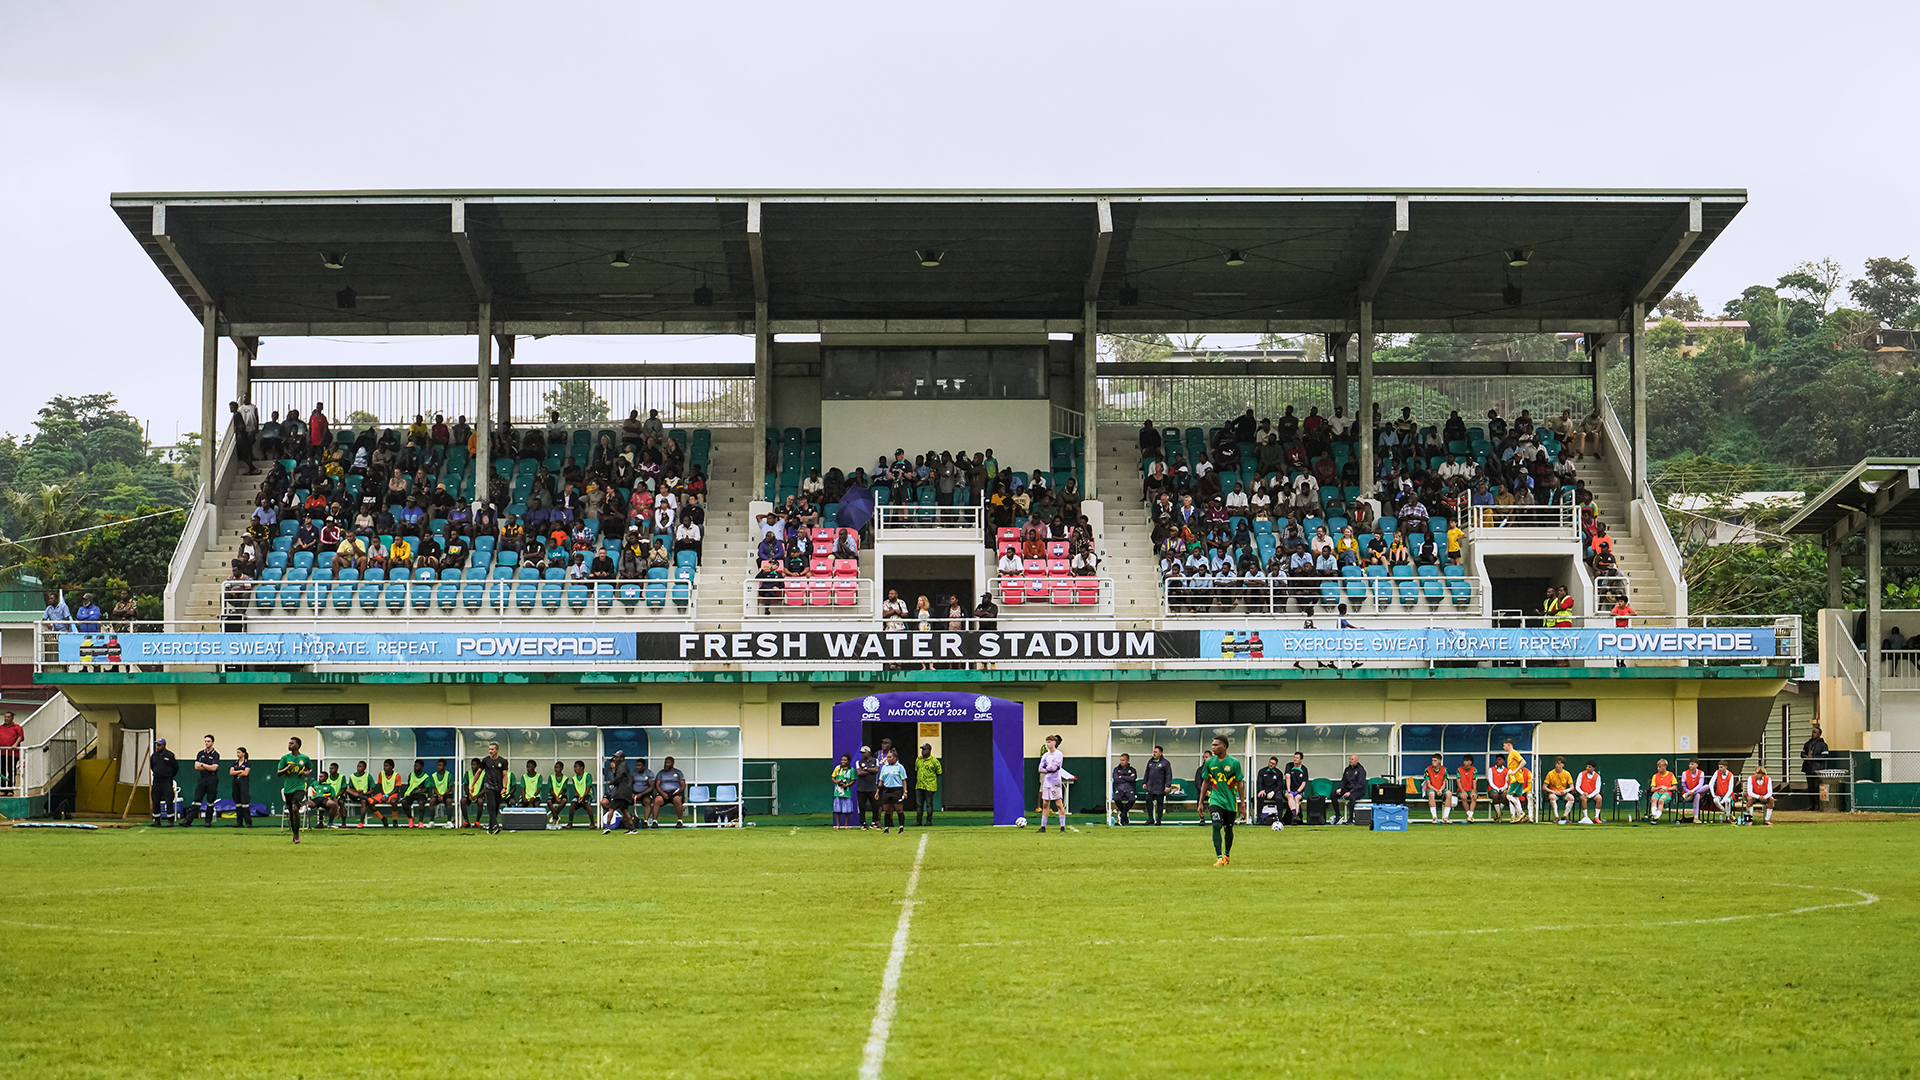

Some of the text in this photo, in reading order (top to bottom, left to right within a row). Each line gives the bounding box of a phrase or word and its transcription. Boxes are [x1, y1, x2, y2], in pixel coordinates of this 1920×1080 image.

[142, 641, 442, 655] EXERCISE. SWEAT. HYDRATE. REPEAT.
[679, 632, 1155, 658] FRESH WATER STADIUM
[1284, 636, 1584, 651] EXERCISE. SWEAT. HYDRATE. REPEAT.
[1217, 773, 1227, 781] 21
[1211, 812, 1220, 821] 21
